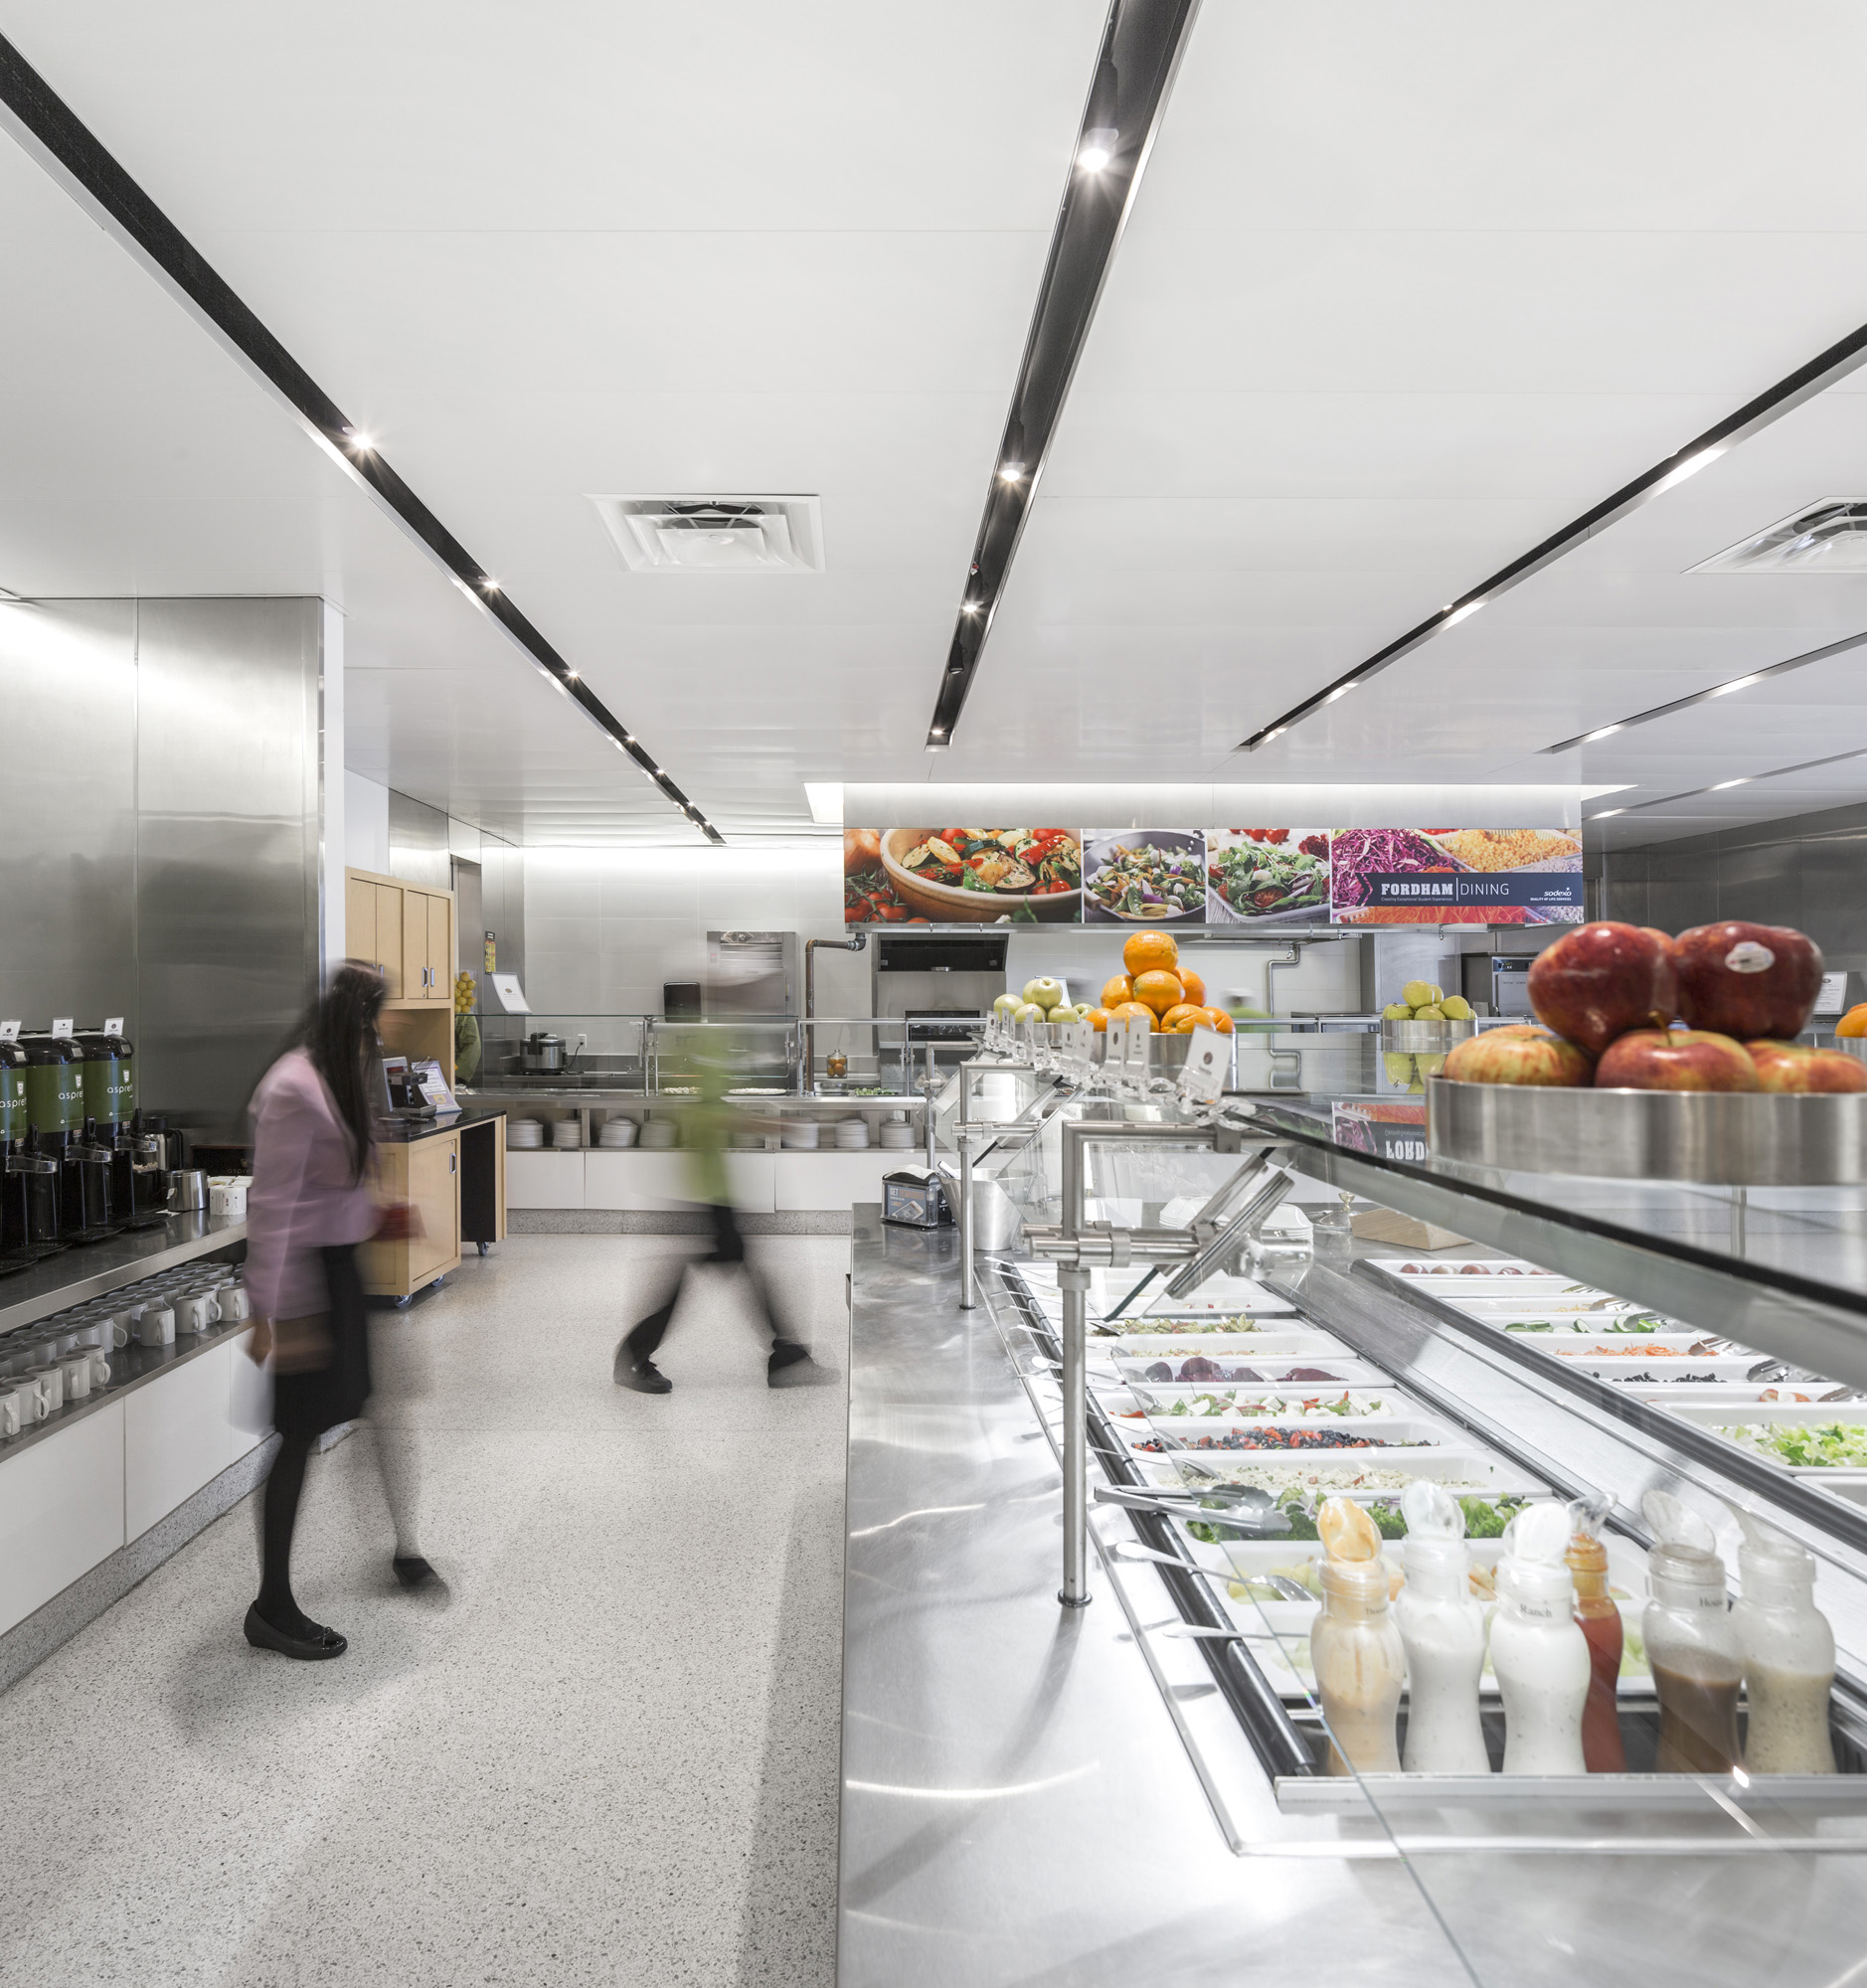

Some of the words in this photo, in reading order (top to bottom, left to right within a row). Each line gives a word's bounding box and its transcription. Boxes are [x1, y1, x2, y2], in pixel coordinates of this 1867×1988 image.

[1381, 883, 1453, 896] FORDHAM
[1460, 883, 1509, 896] DINING
[1544, 887, 1572, 897] sodexo
[59, 1089, 84, 1100] aspre
[1520, 1603, 1553, 1618] Ranch
